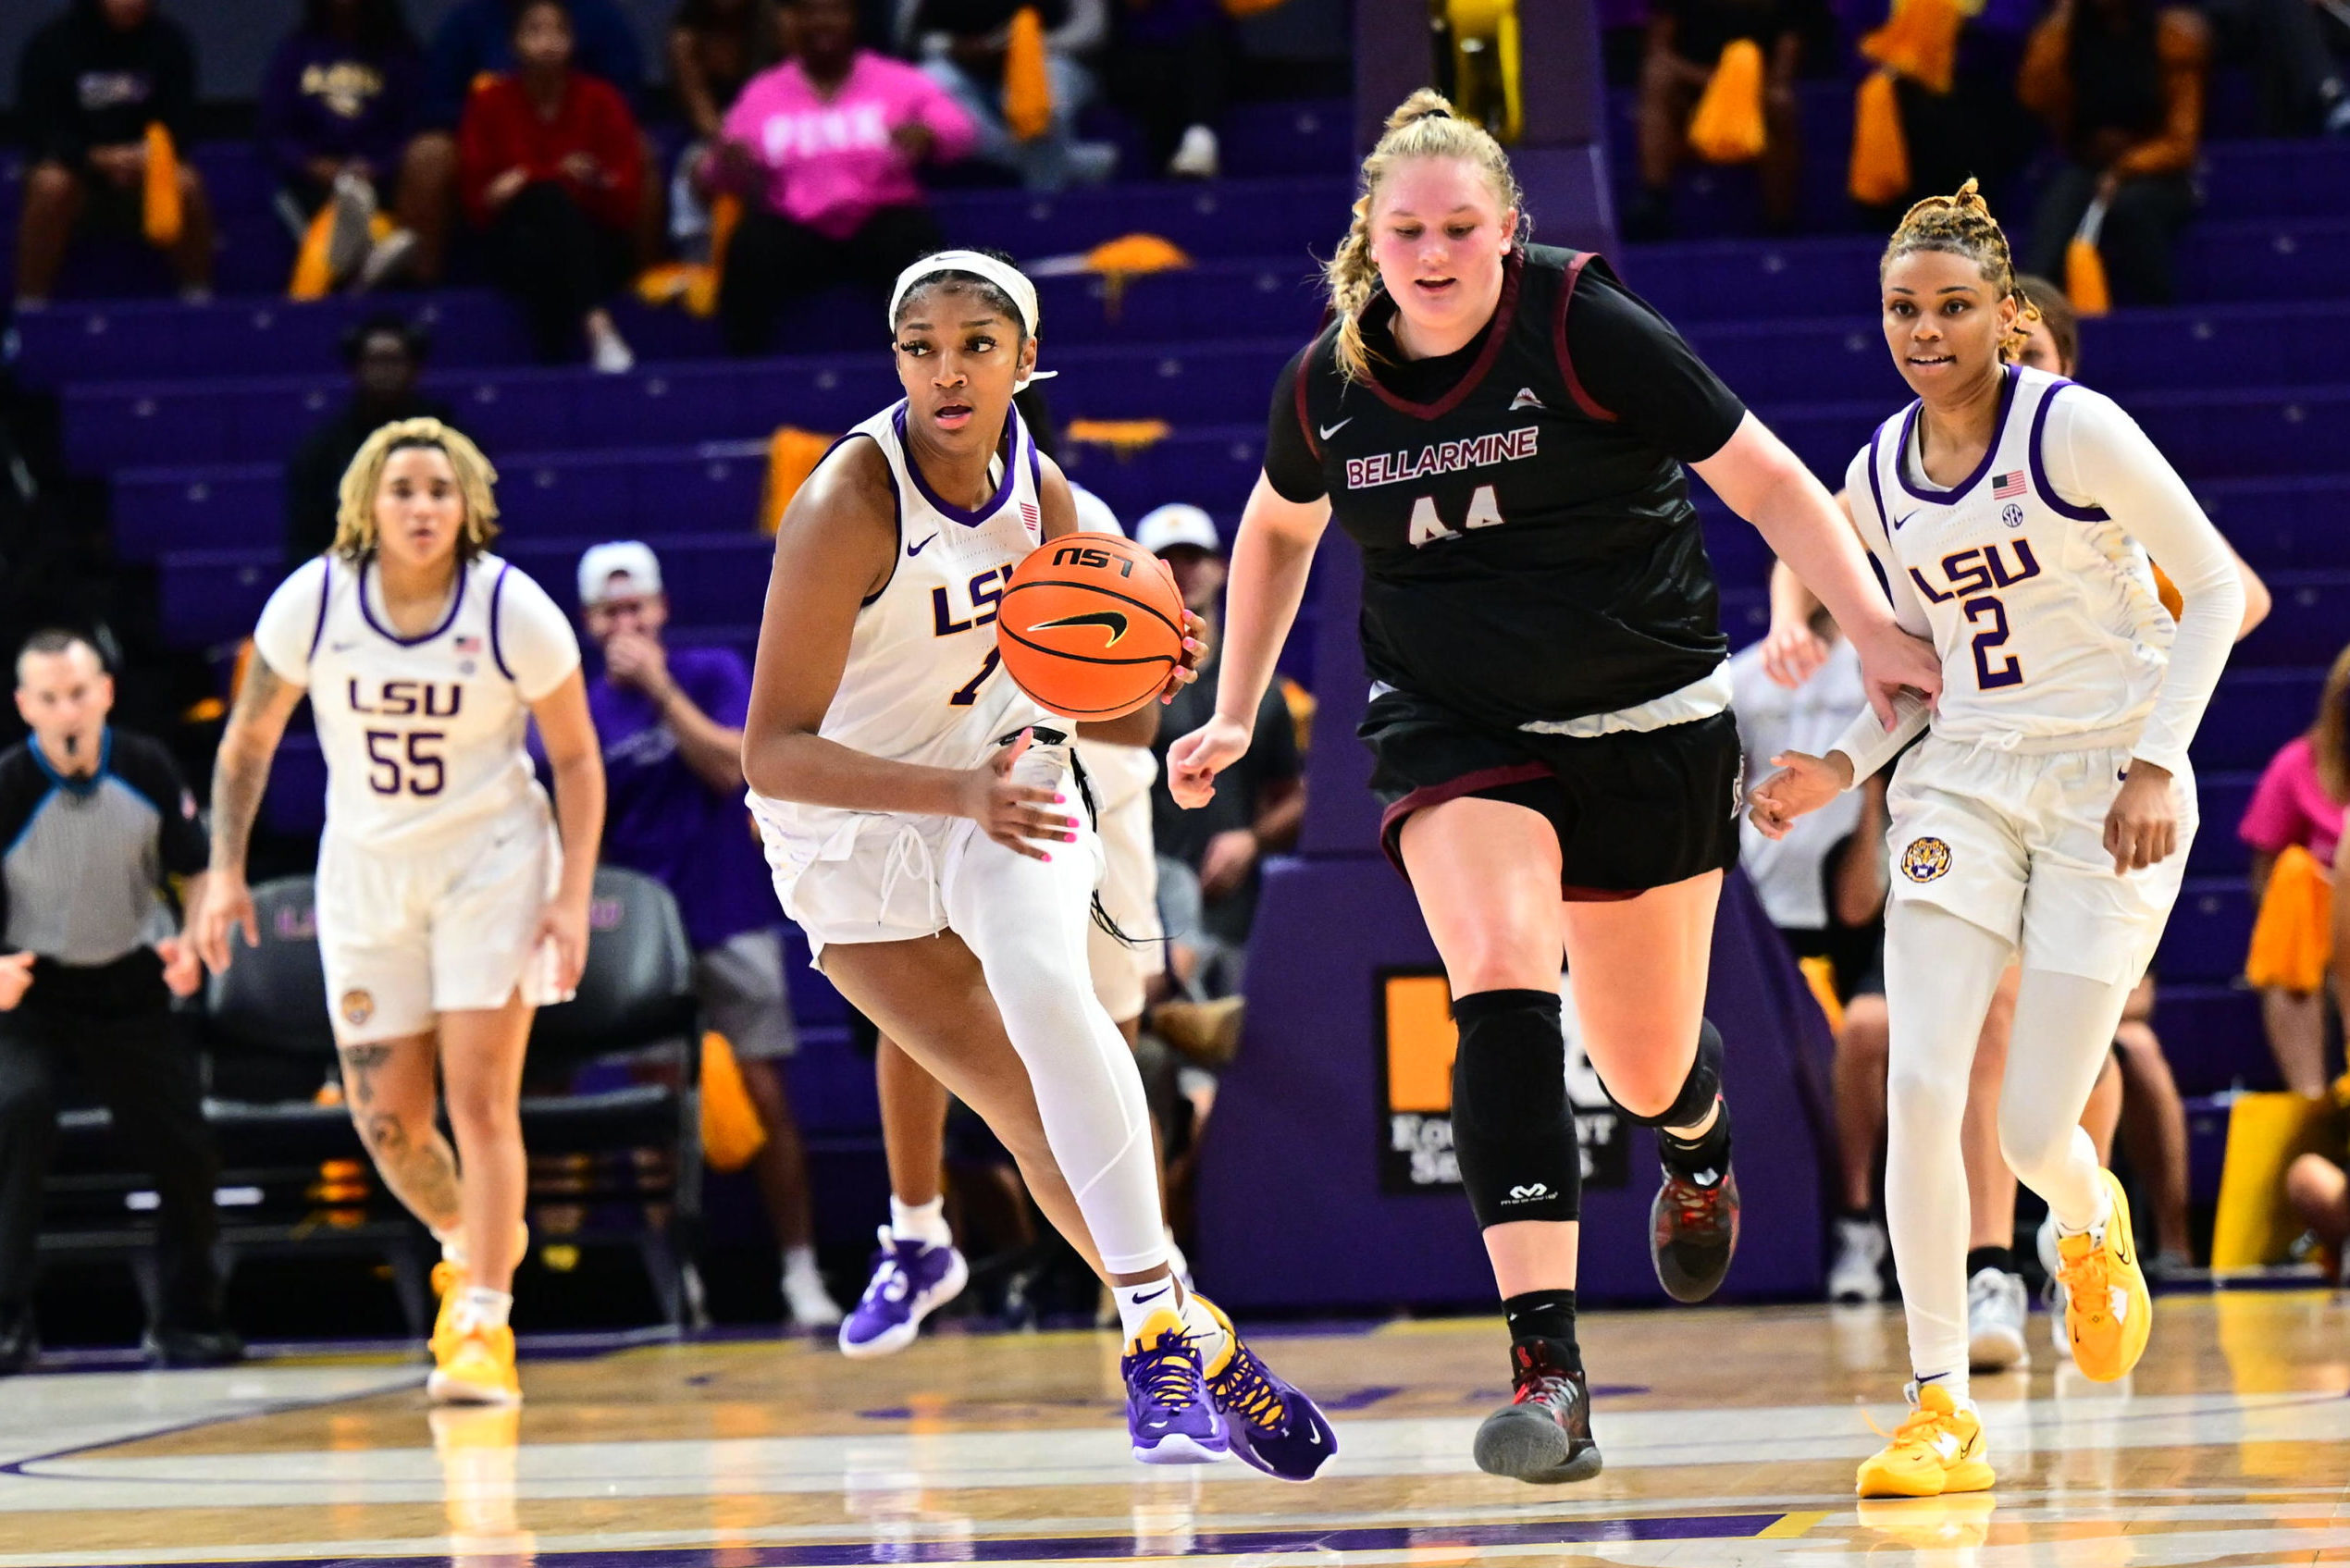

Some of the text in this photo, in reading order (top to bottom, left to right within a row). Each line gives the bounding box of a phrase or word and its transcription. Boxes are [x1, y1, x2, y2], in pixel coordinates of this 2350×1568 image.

[1346, 426, 1539, 489] BELLARMINE
[2002, 503, 2023, 527] SEC
[1052, 548, 1134, 579] LSU
[1907, 537, 2041, 605] LSU
[931, 562, 1014, 636] LS
[1963, 595, 2024, 690] 2
[348, 677, 462, 717] LSU
[365, 729, 445, 796] 55
